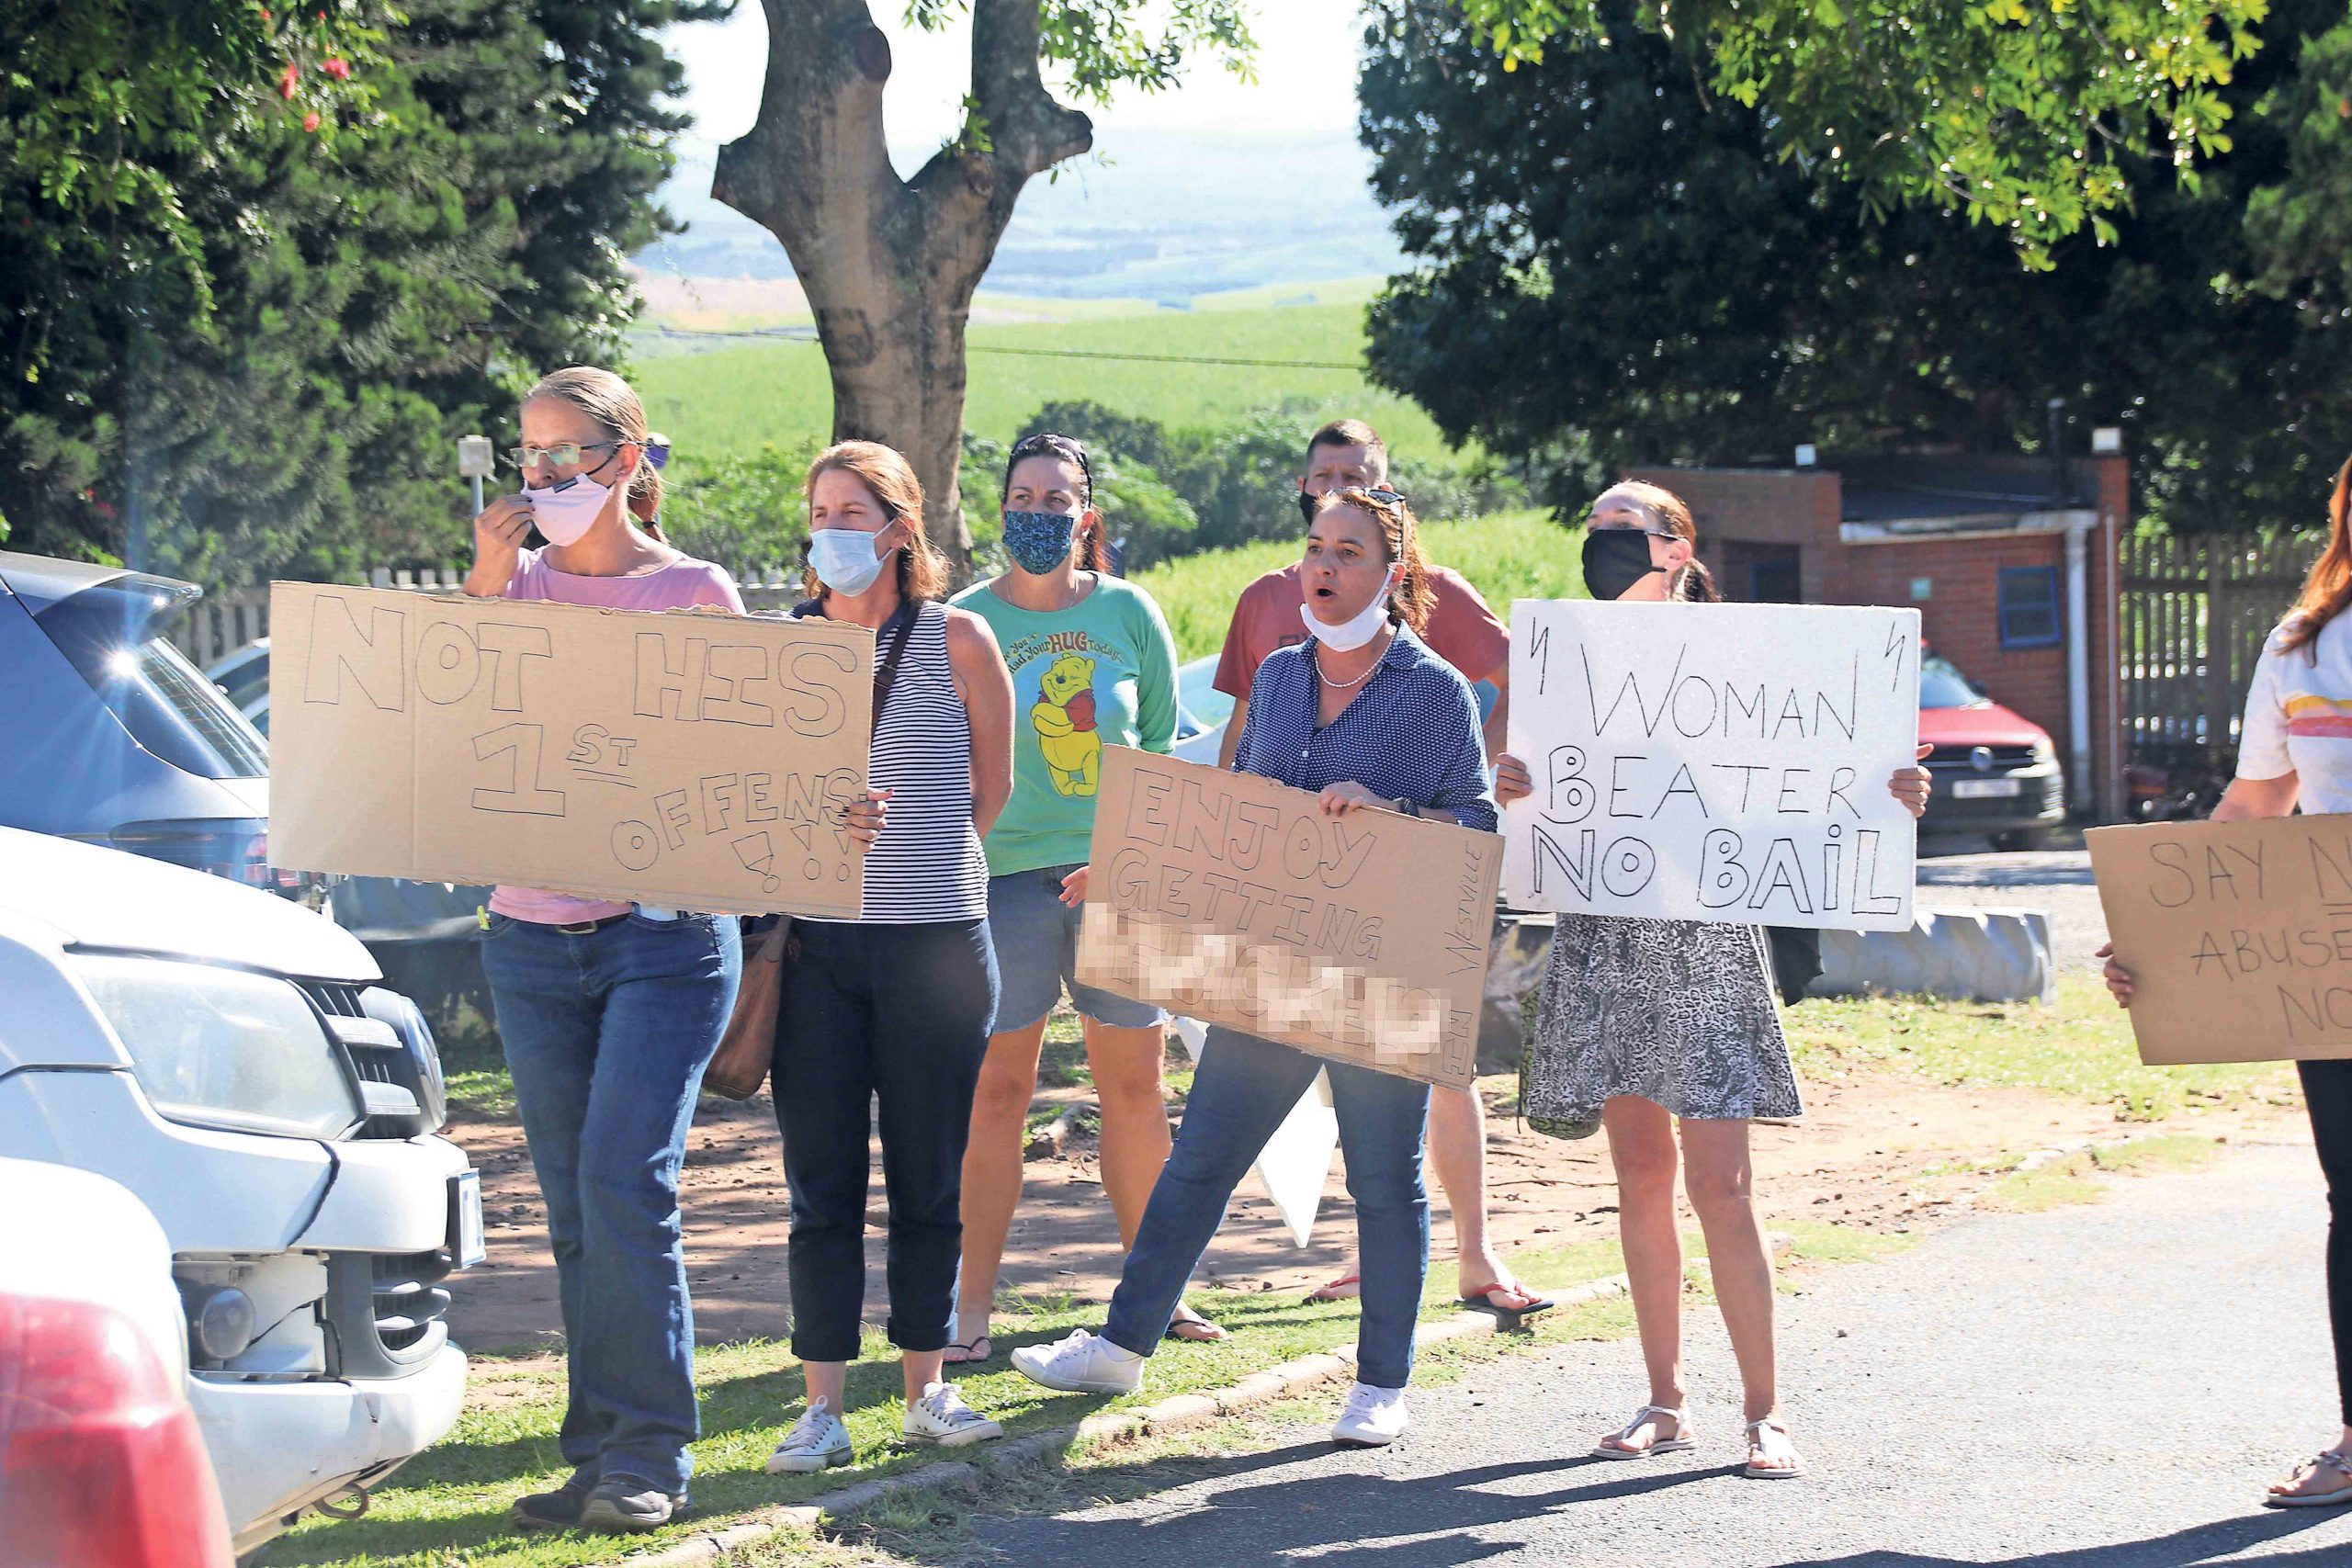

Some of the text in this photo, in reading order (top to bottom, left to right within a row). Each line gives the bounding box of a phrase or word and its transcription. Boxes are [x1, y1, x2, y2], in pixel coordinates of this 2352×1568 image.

[304, 593, 858, 738] NOT HIS
[1024, 640, 1052, 661] Your
[1048, 630, 1089, 654] HUG
[1580, 642, 1859, 742] WOMAN
[611, 767, 867, 872] OFFENS
[1125, 768, 1378, 889] ENJOY
[1539, 744, 1861, 825] BEATER
[1107, 847, 1383, 962] GETTING
[1532, 824, 1657, 902] NO
[2148, 839, 2264, 908] SAY
